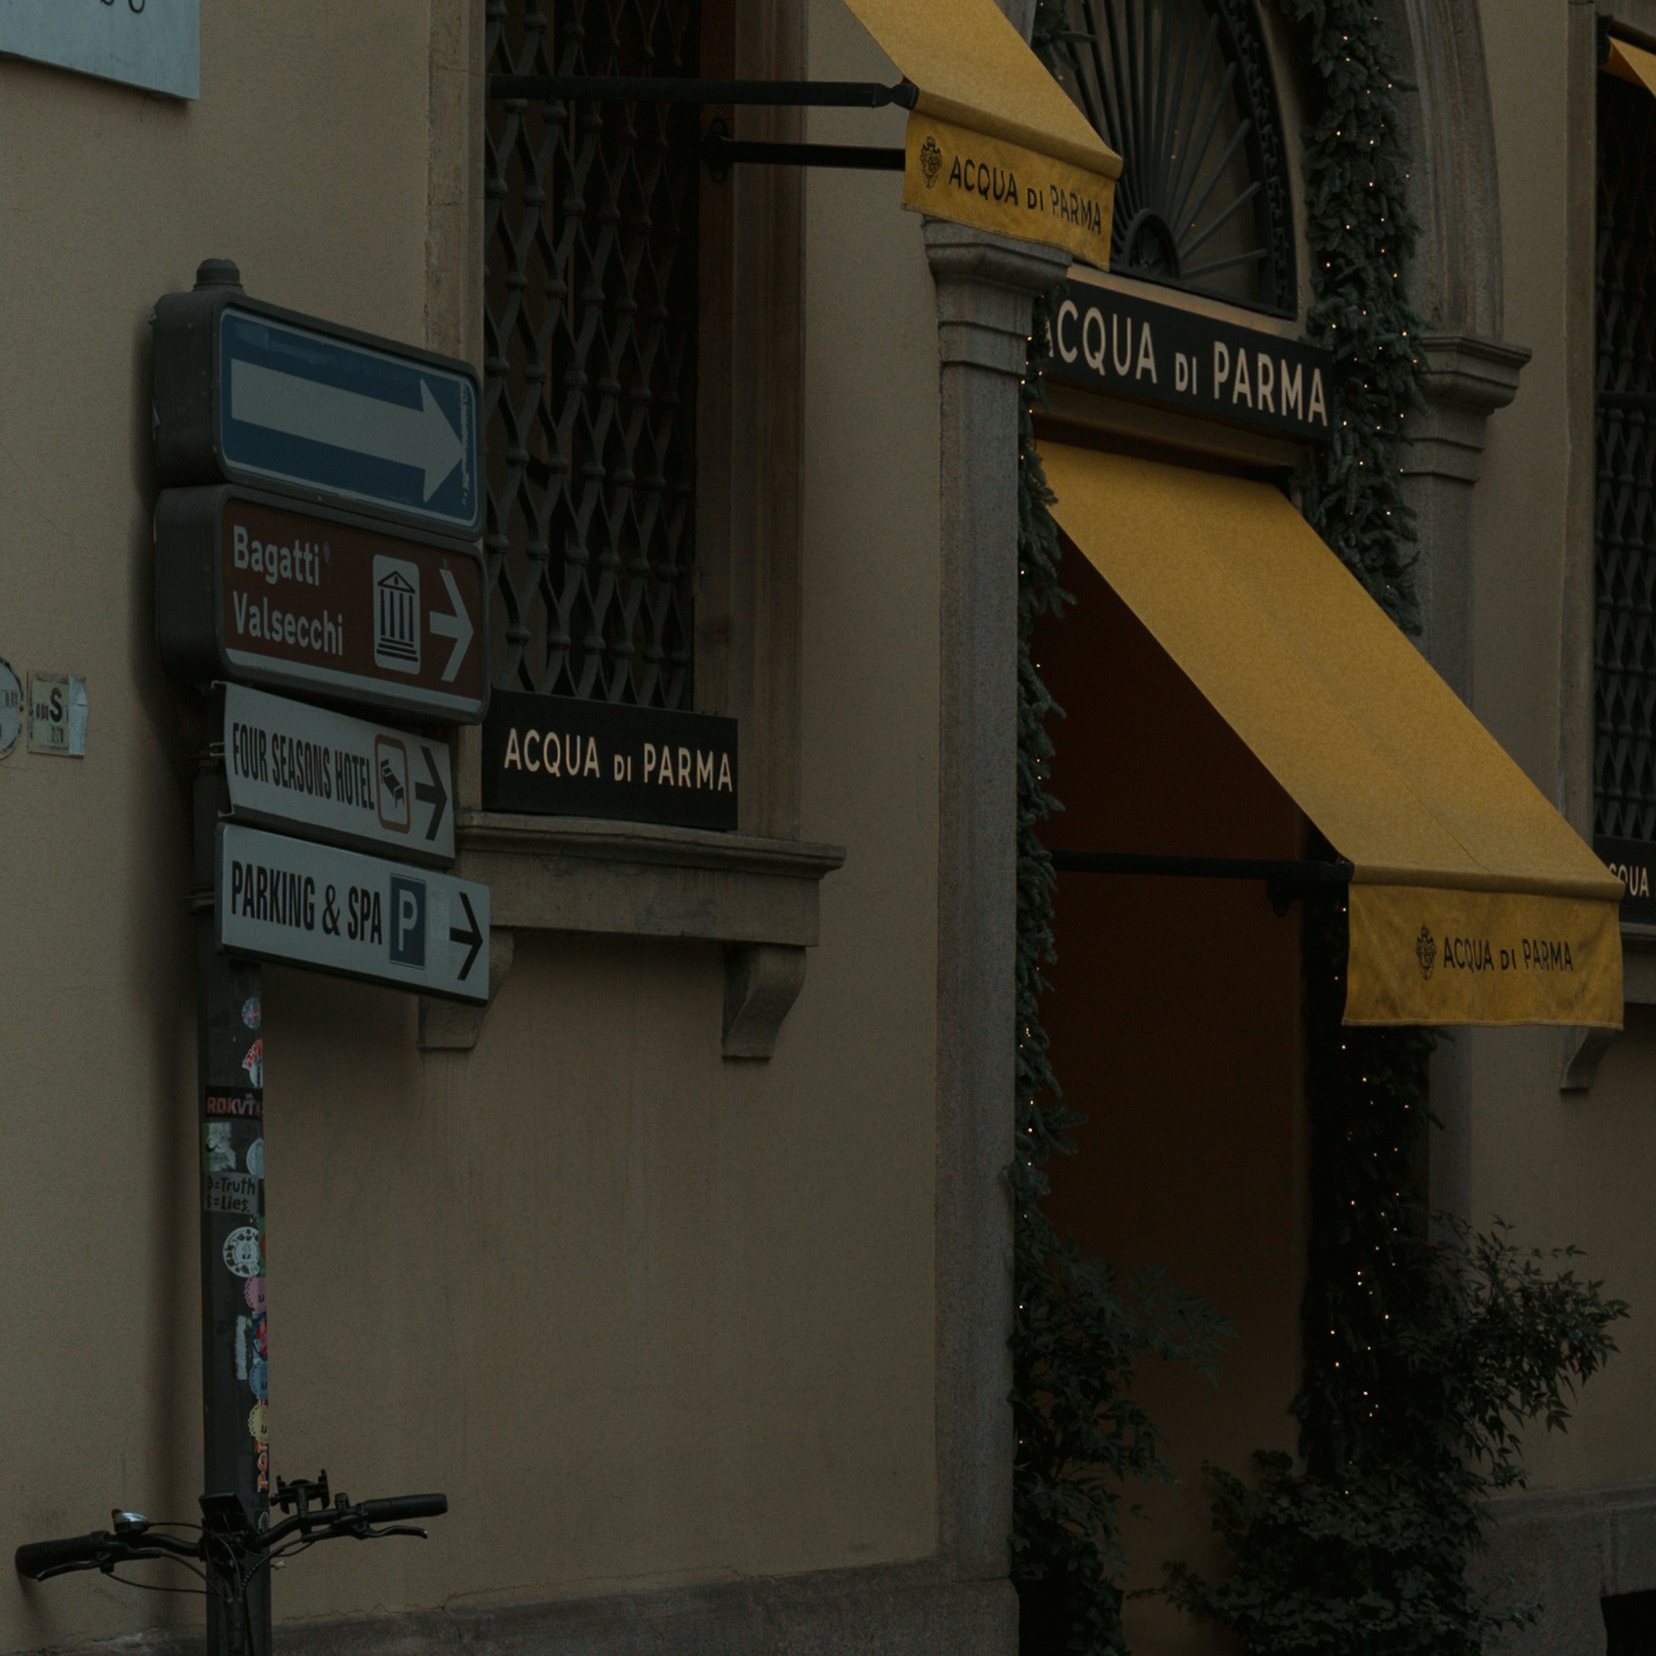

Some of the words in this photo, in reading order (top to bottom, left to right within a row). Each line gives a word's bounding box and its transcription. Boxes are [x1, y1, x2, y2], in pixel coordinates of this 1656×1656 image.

[949, 155, 1018, 206] ACQUA
[1050, 184, 1101, 235] PARMA
[1175, 352, 1197, 395] DI
[1213, 340, 1328, 427] PARMA
[232, 524, 320, 587] Bagatti
[232, 590, 343, 656] Valsecchi
[233, 722, 269, 783] FOUR
[271, 732, 332, 799] SEASONS
[335, 749, 375, 810] HOTEL
[503, 727, 600, 779] ACQUA
[613, 753, 632, 783] DI
[643, 742, 733, 793] PARMA
[231, 860, 316, 931] PARKING
[322, 884, 341, 936] &
[348, 886, 383, 945] SPA
[1443, 936, 1495, 973] ACQUA
[1522, 938, 1574, 972] PARMA
